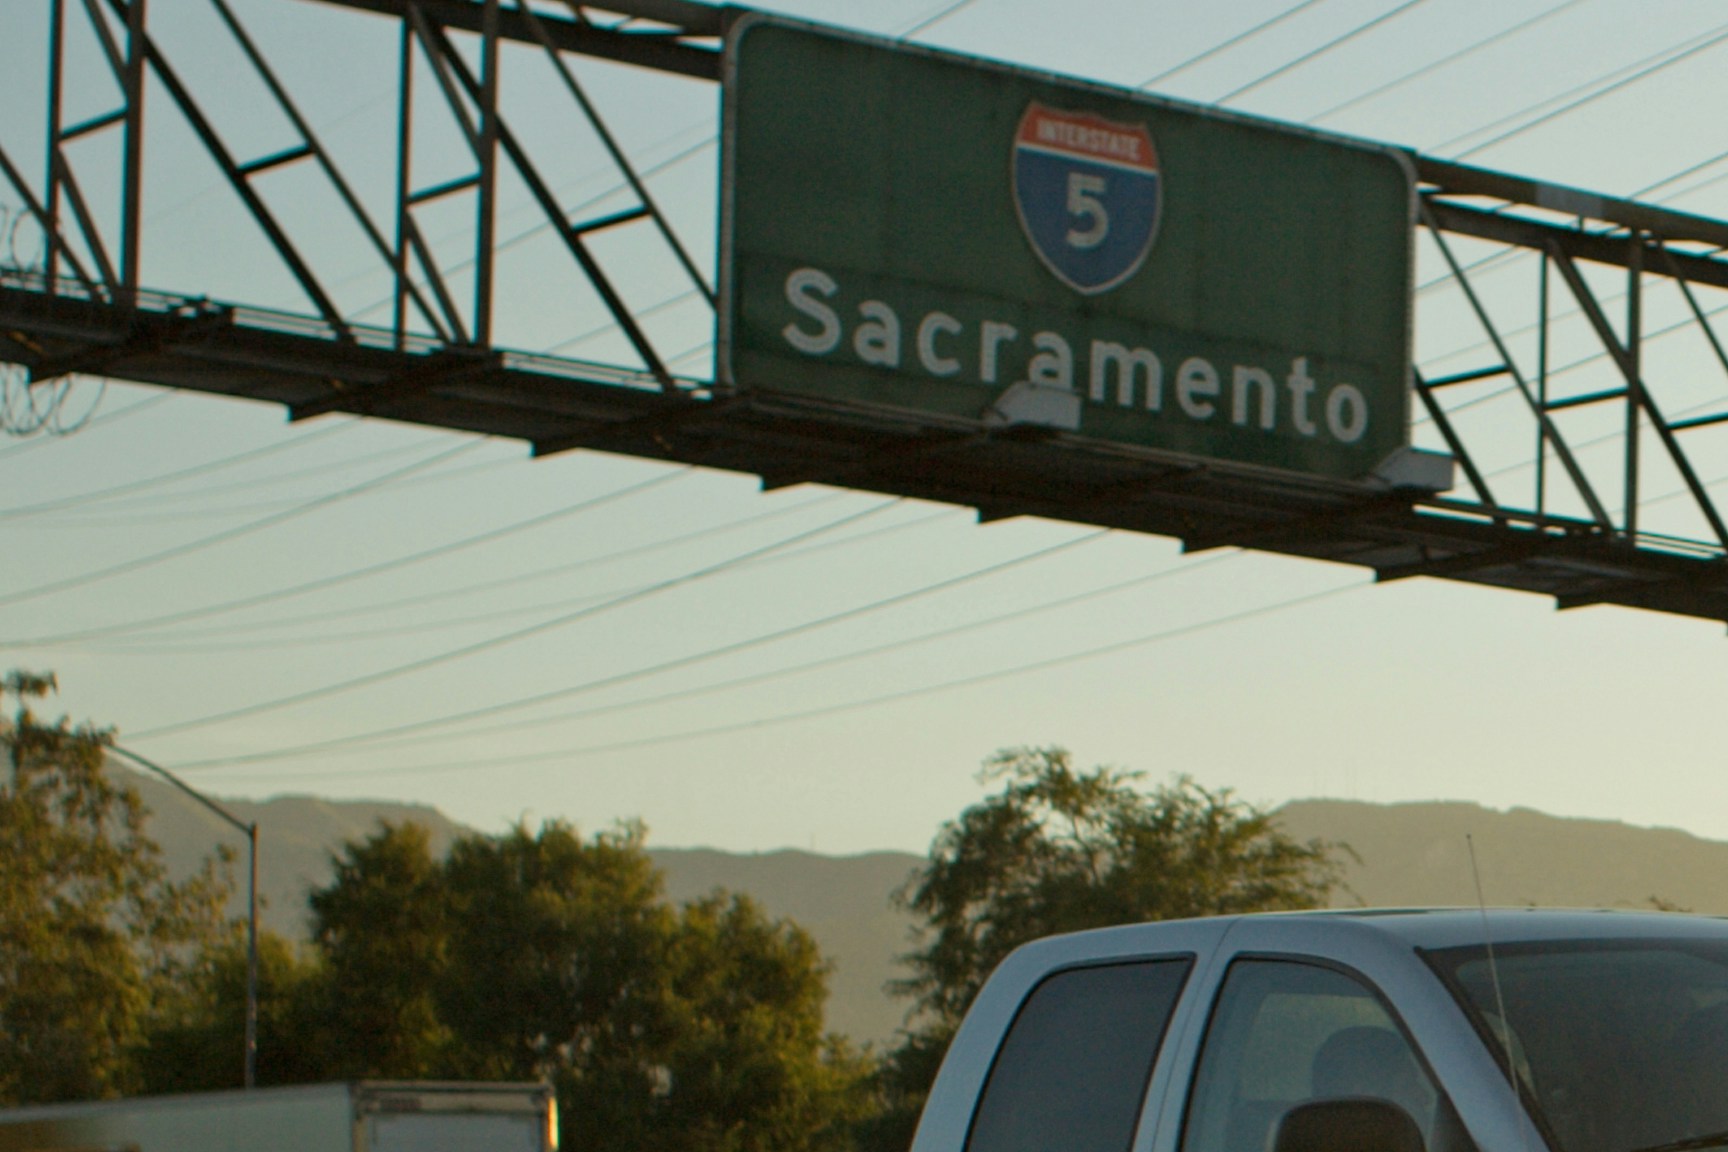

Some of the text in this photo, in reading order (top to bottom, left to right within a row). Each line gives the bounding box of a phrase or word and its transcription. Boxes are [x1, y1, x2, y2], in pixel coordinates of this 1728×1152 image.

[1036, 119, 1142, 162] INTERSTATE
[1066, 172, 1109, 248] 5
[783, 267, 1368, 443] Sacramento
